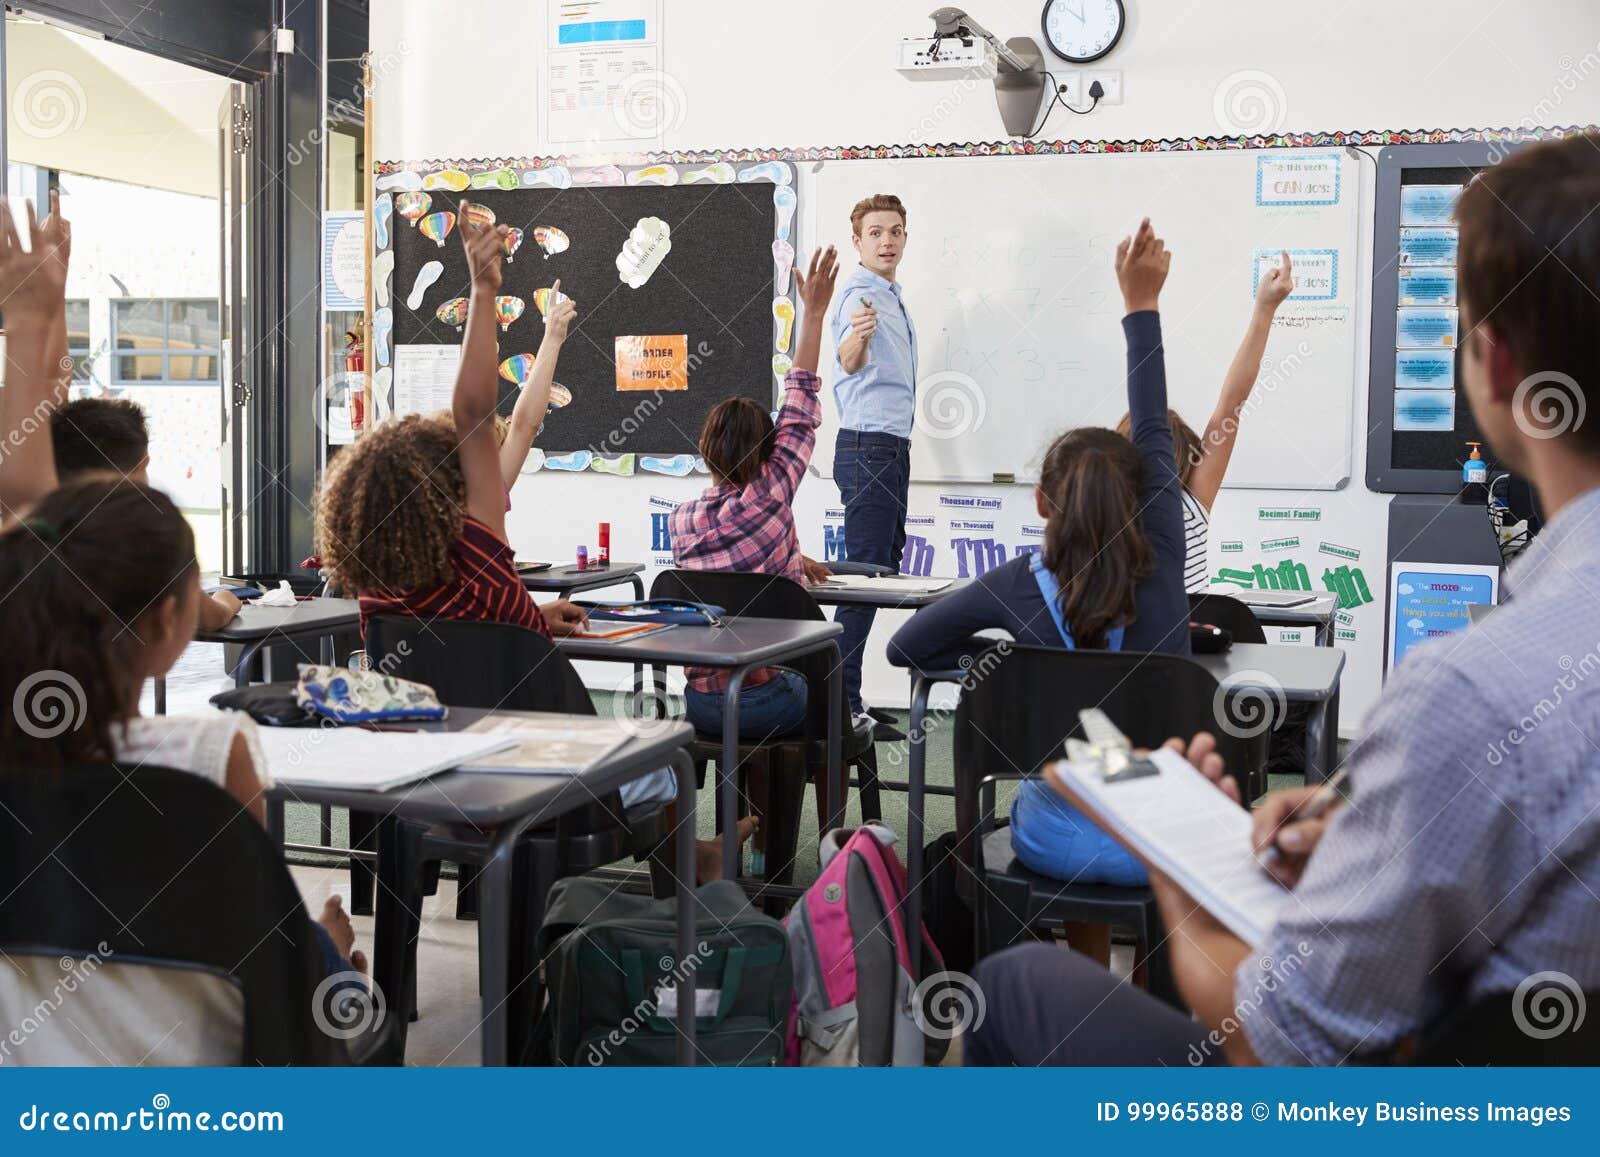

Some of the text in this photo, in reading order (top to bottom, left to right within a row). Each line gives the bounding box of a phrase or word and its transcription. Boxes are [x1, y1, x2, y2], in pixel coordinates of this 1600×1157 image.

[940, 496, 1001, 509] Thousand Family
[1259, 510, 1321, 520] Decimal Family
[963, 522, 994, 530] Thousands
[1430, 583, 1459, 592] more
